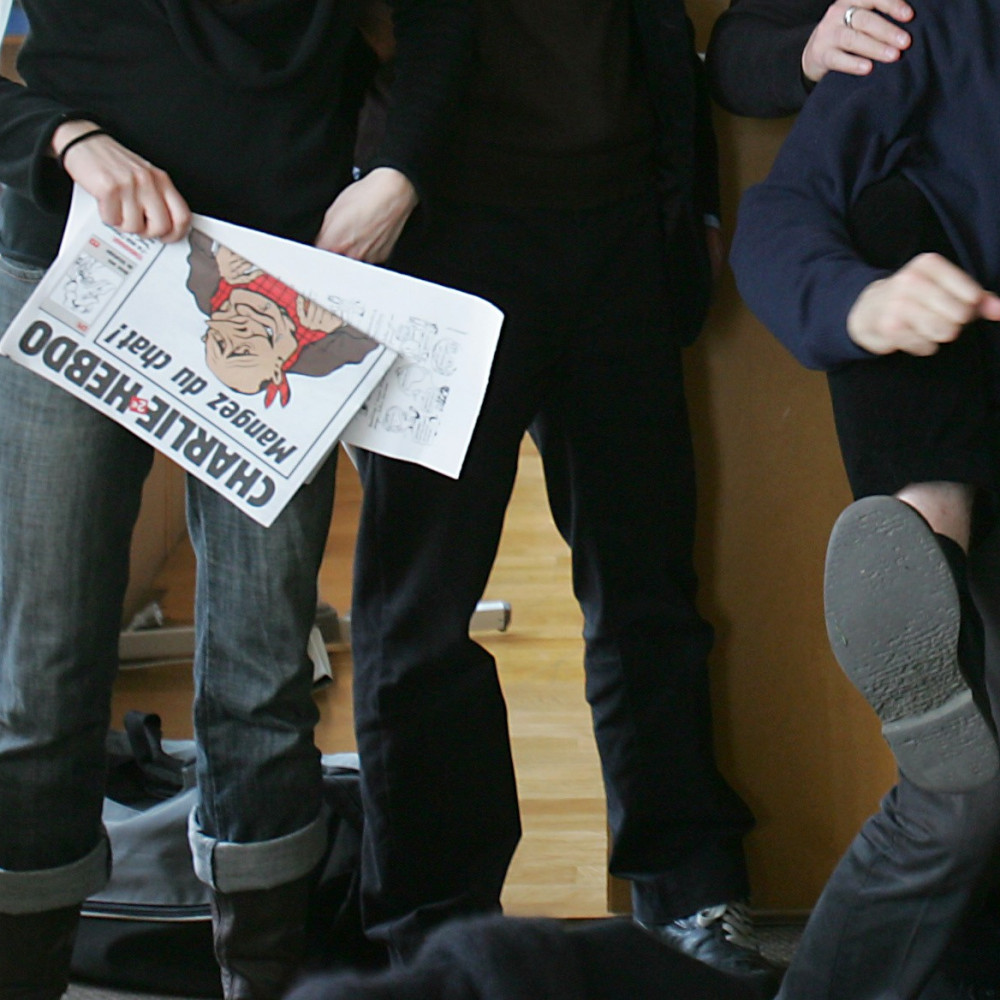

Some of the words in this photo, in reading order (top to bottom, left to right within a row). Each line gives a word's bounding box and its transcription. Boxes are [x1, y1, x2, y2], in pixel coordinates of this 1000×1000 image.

[18, 320, 143, 414] HEBDO
[104, 323, 172, 370] chat!
[171, 366, 208, 395] du
[135, 395, 276, 507] CHARLIE
[206, 392, 298, 464] Mangez
